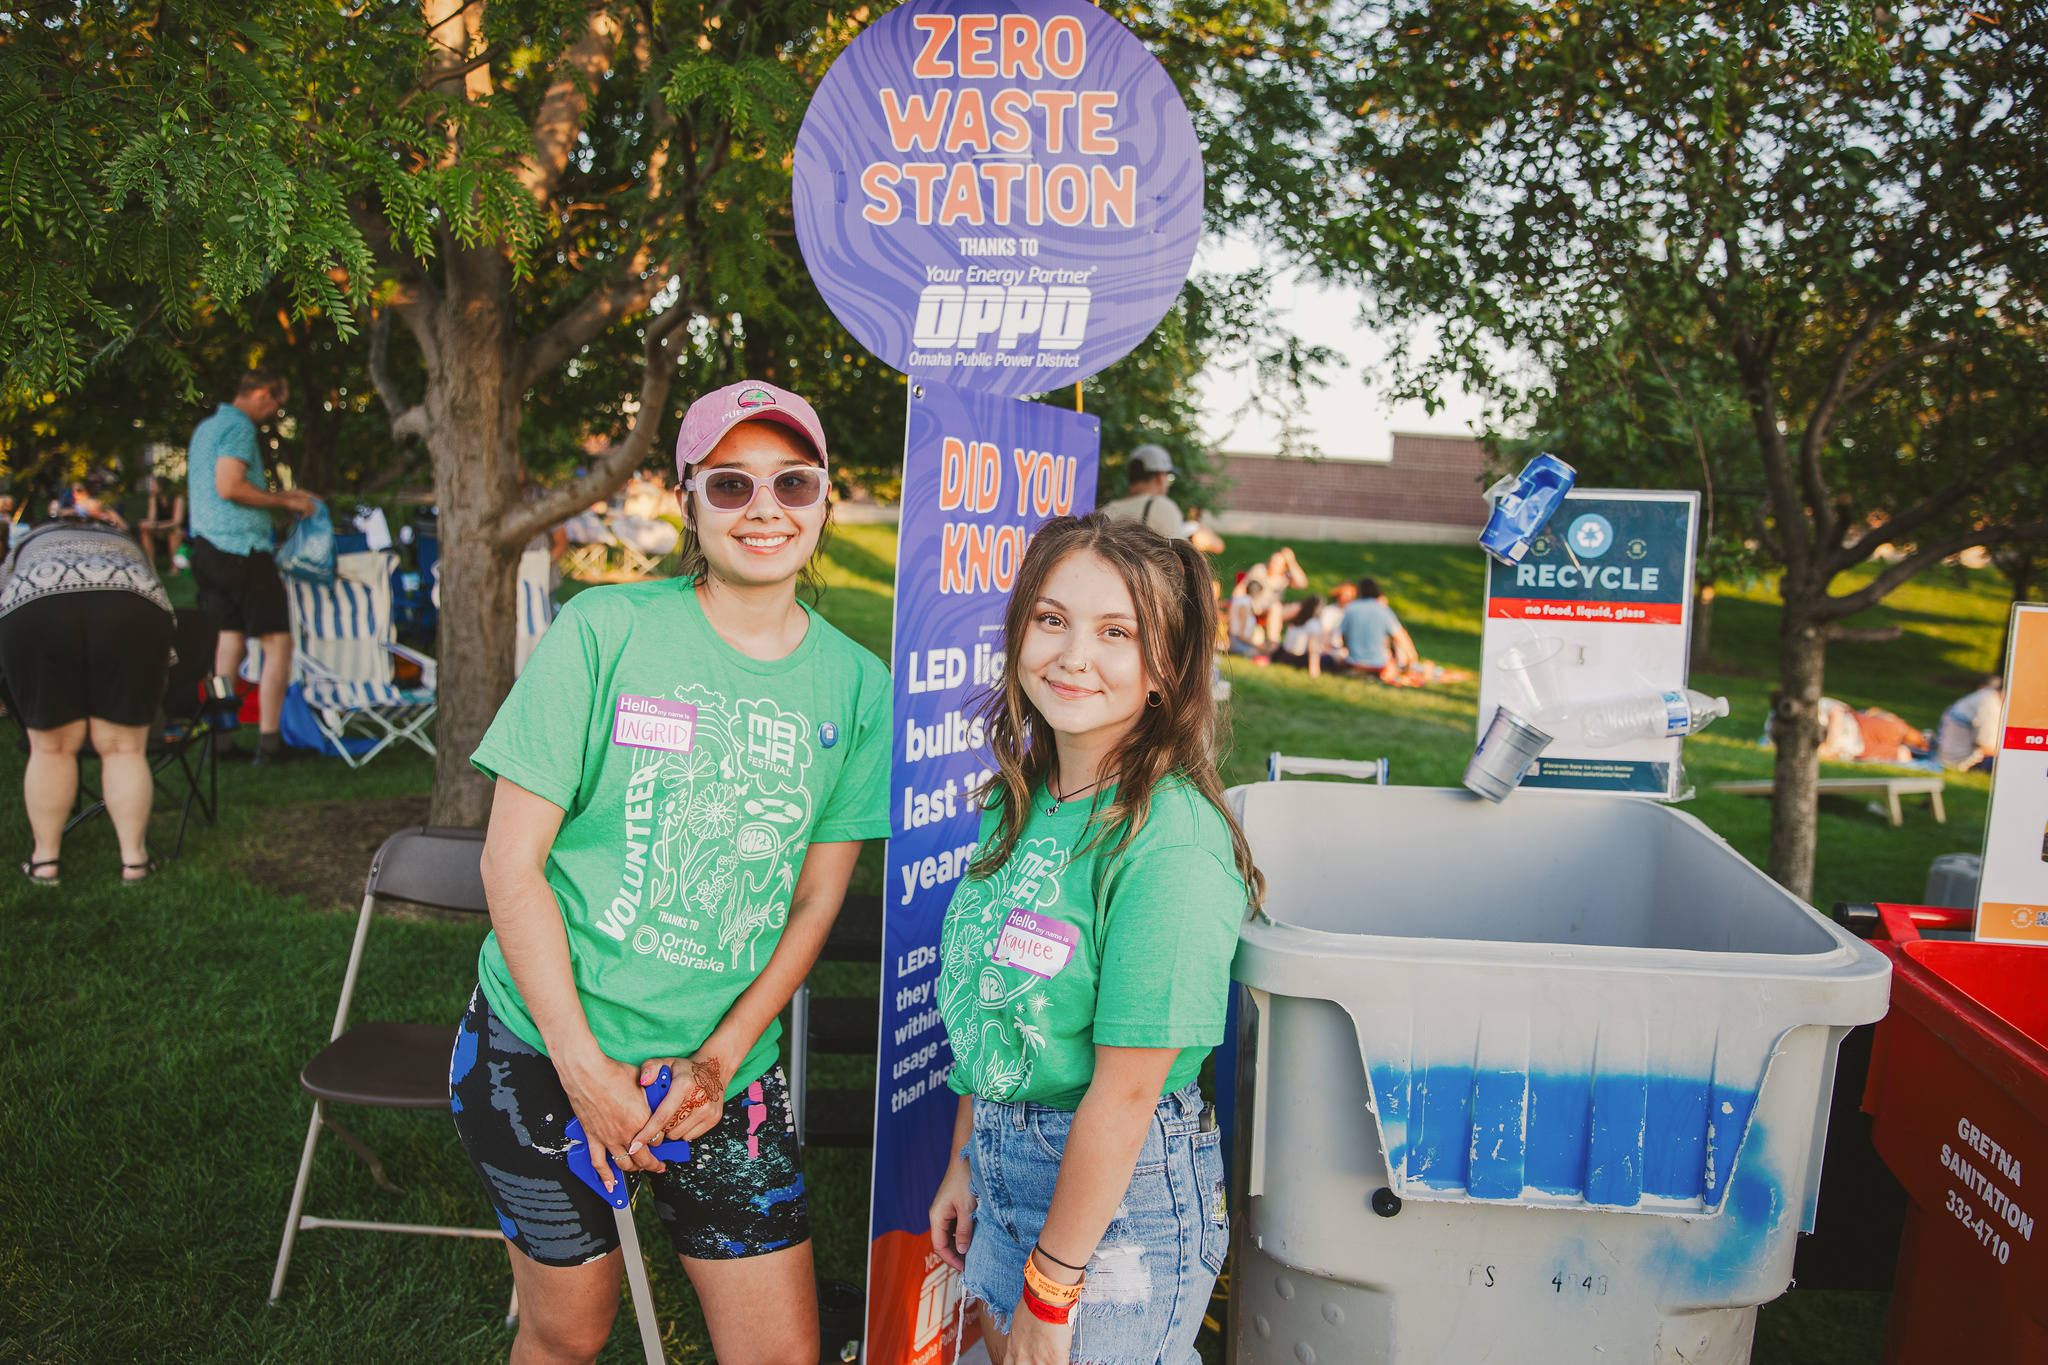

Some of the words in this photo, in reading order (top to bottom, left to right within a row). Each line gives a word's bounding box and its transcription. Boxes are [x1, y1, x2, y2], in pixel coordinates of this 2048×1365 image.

[913, 14, 1087, 80] ZERO
[879, 87, 1119, 155] WASTE
[860, 161, 1137, 228] STATION
[958, 237, 1017, 256] THANKS
[1019, 238, 1039, 257] TO
[925, 265, 964, 282] Your
[966, 265, 1025, 286] Energy
[912, 285, 1092, 350] OPPD
[908, 351, 952, 366] Omaha
[954, 351, 993, 367] Public
[994, 352, 1035, 367] Power
[1036, 353, 1081, 368] District
[939, 436, 1001, 513] DID
[1014, 448, 1077, 518] YOU
[1516, 564, 1660, 591] RECYCLE
[1525, 605, 1541, 615] no
[1542, 604, 1575, 617] food,
[1576, 605, 1614, 619] liquid,
[1615, 607, 1646, 620] glass
[908, 647, 967, 695] LED
[620, 697, 658, 714] Hello
[668, 711, 684, 719] name
[621, 718, 688, 745] INGRID
[905, 710, 985, 763] bulbs
[2025, 735, 2044, 745] no
[747, 755, 792, 777] FESTIVAL
[903, 779, 958, 830] last
[595, 758, 665, 942] VOLUNTEER
[657, 911, 688, 929] THANKS
[689, 919, 700, 931] TO
[1008, 910, 1037, 931] Hello
[1035, 927, 1045, 936] my
[1045, 930, 1063, 940] name
[1062, 935, 1069, 943] is
[656, 945, 725, 973] Nebraska
[662, 932, 707, 956] Ortho
[898, 946, 937, 978] LEDs
[896, 980, 931, 1012] they
[895, 1007, 941, 1046] within
[893, 1041, 938, 1080] usage
[891, 1079, 926, 1113] than
[1958, 1117, 2021, 1187] GRETNA
[1940, 1143, 2034, 1242] SANITATION
[1946, 1189, 2010, 1265] 332-4710
